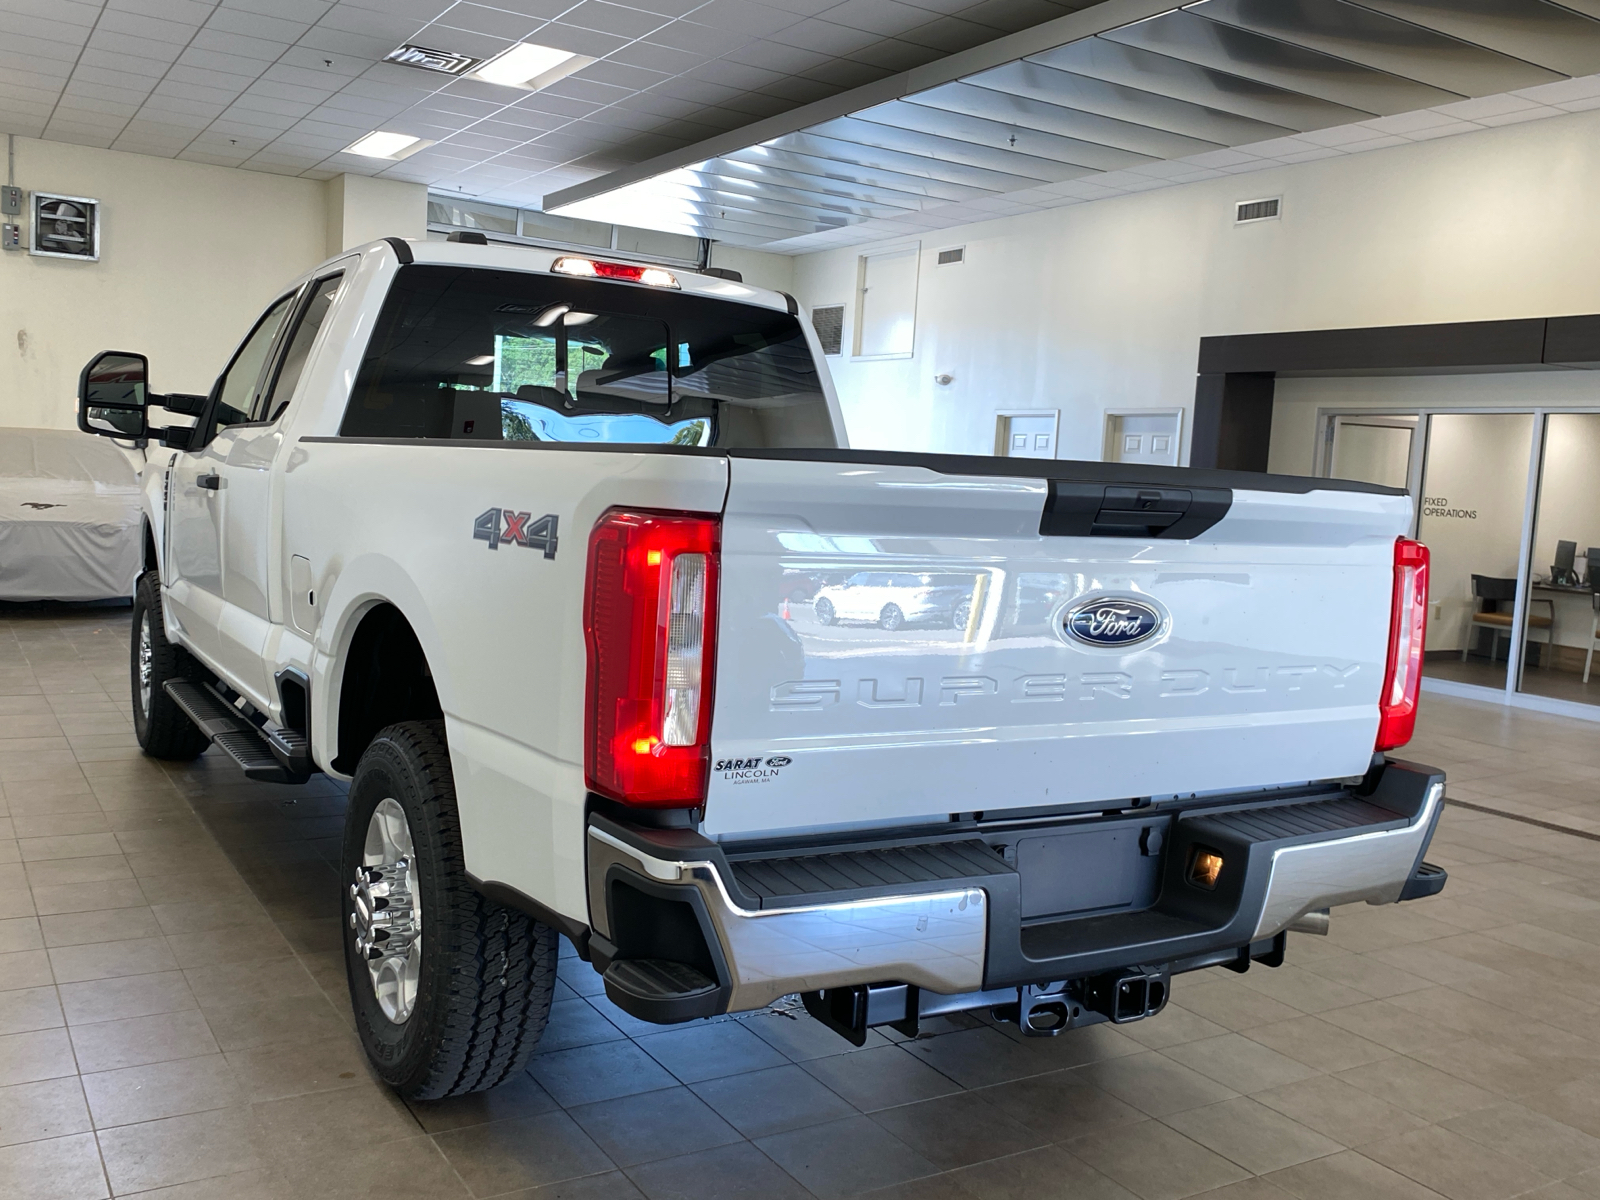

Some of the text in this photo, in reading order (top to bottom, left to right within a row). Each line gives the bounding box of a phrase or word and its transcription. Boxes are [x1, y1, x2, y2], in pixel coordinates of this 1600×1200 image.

[1424, 497, 1448, 507] FIXED
[1423, 507, 1477, 519] OPERATIONS
[1089, 607, 1143, 636] Ford
[769, 662, 1361, 711] SUPER DUTY
[714, 757, 763, 772] SARAT
[724, 769, 779, 780] LINCOLN
